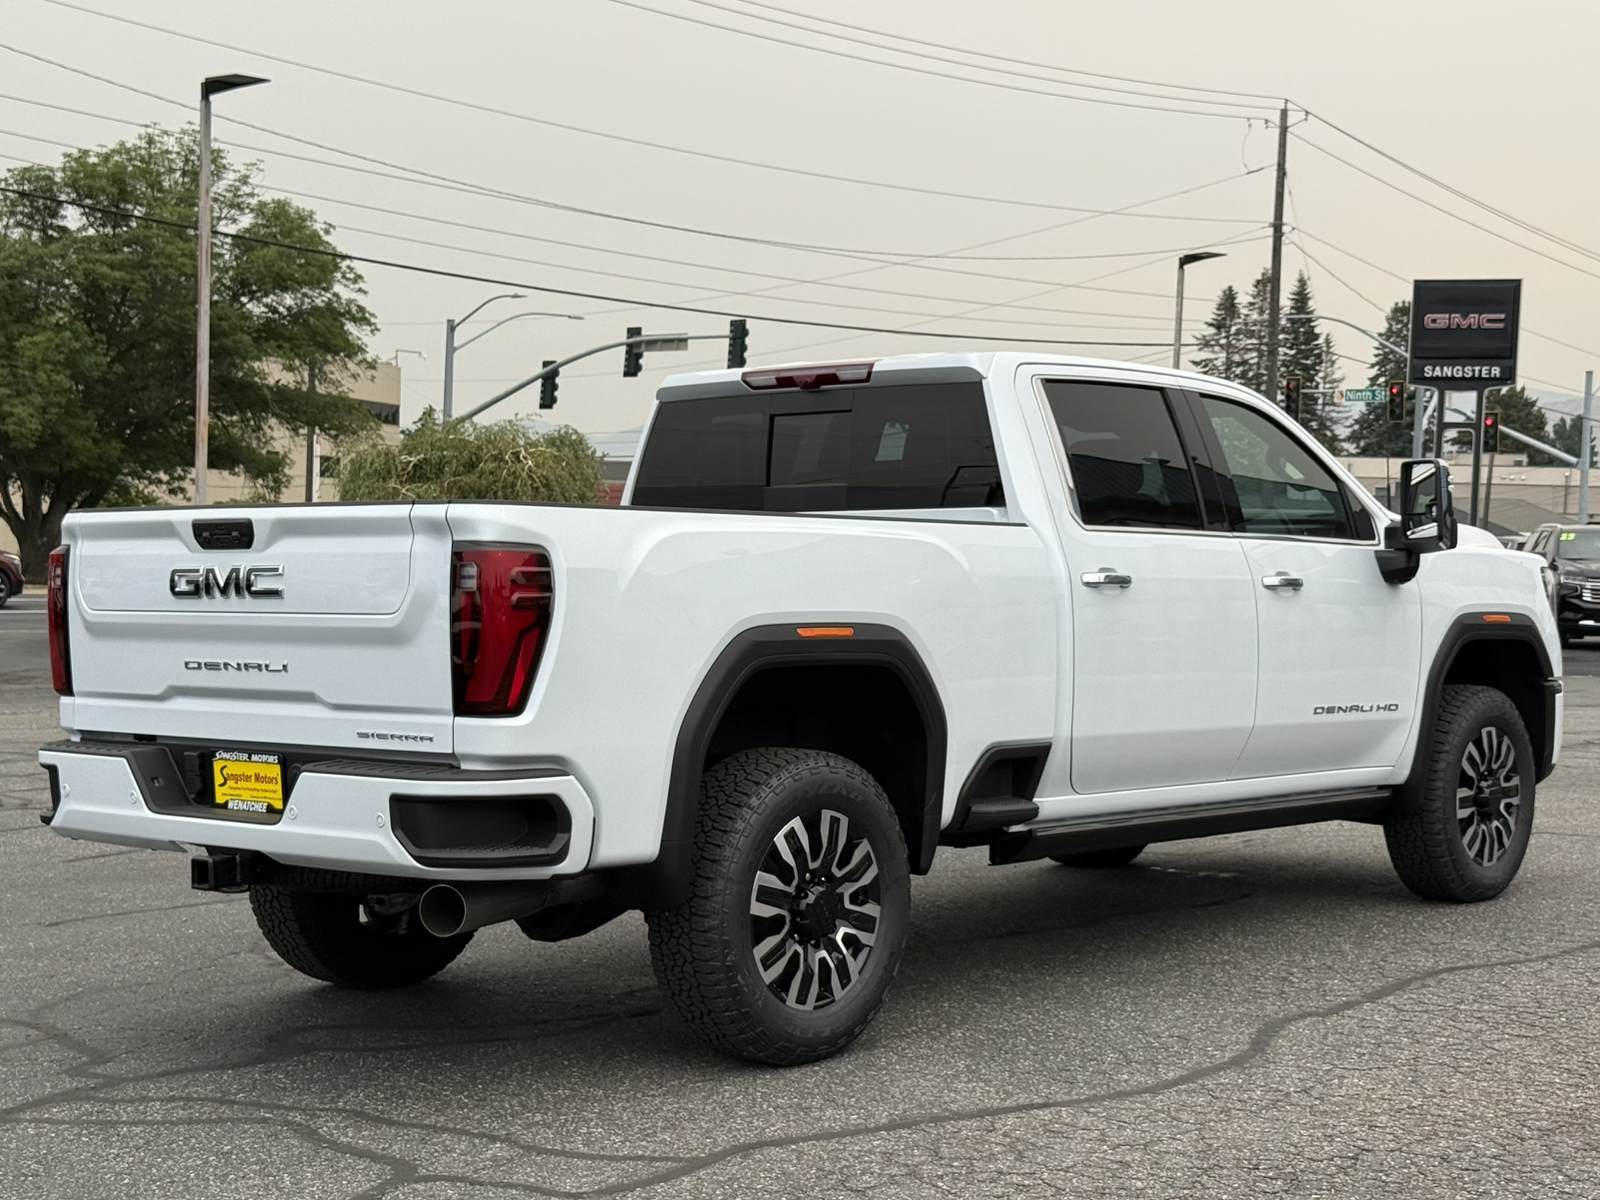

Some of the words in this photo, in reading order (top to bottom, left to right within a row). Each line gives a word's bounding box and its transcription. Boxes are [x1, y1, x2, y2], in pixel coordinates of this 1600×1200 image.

[1424, 313, 1505, 329] GMC
[1423, 365, 1501, 378] SANGSTER
[1346, 390, 1372, 400] Ninth
[1374, 390, 1386, 400] St
[169, 564, 285, 600] GMC
[184, 660, 289, 674] DENALI
[1313, 704, 1374, 716] DENALI
[1376, 703, 1399, 712] HD
[356, 731, 434, 742] SIERRA
[212, 750, 250, 761] SANGSTER
[251, 754, 278, 763] MOTORS
[218, 765, 252, 787] Sangster
[254, 772, 278, 785] Motors
[228, 799, 267, 812] WENATCHEE
